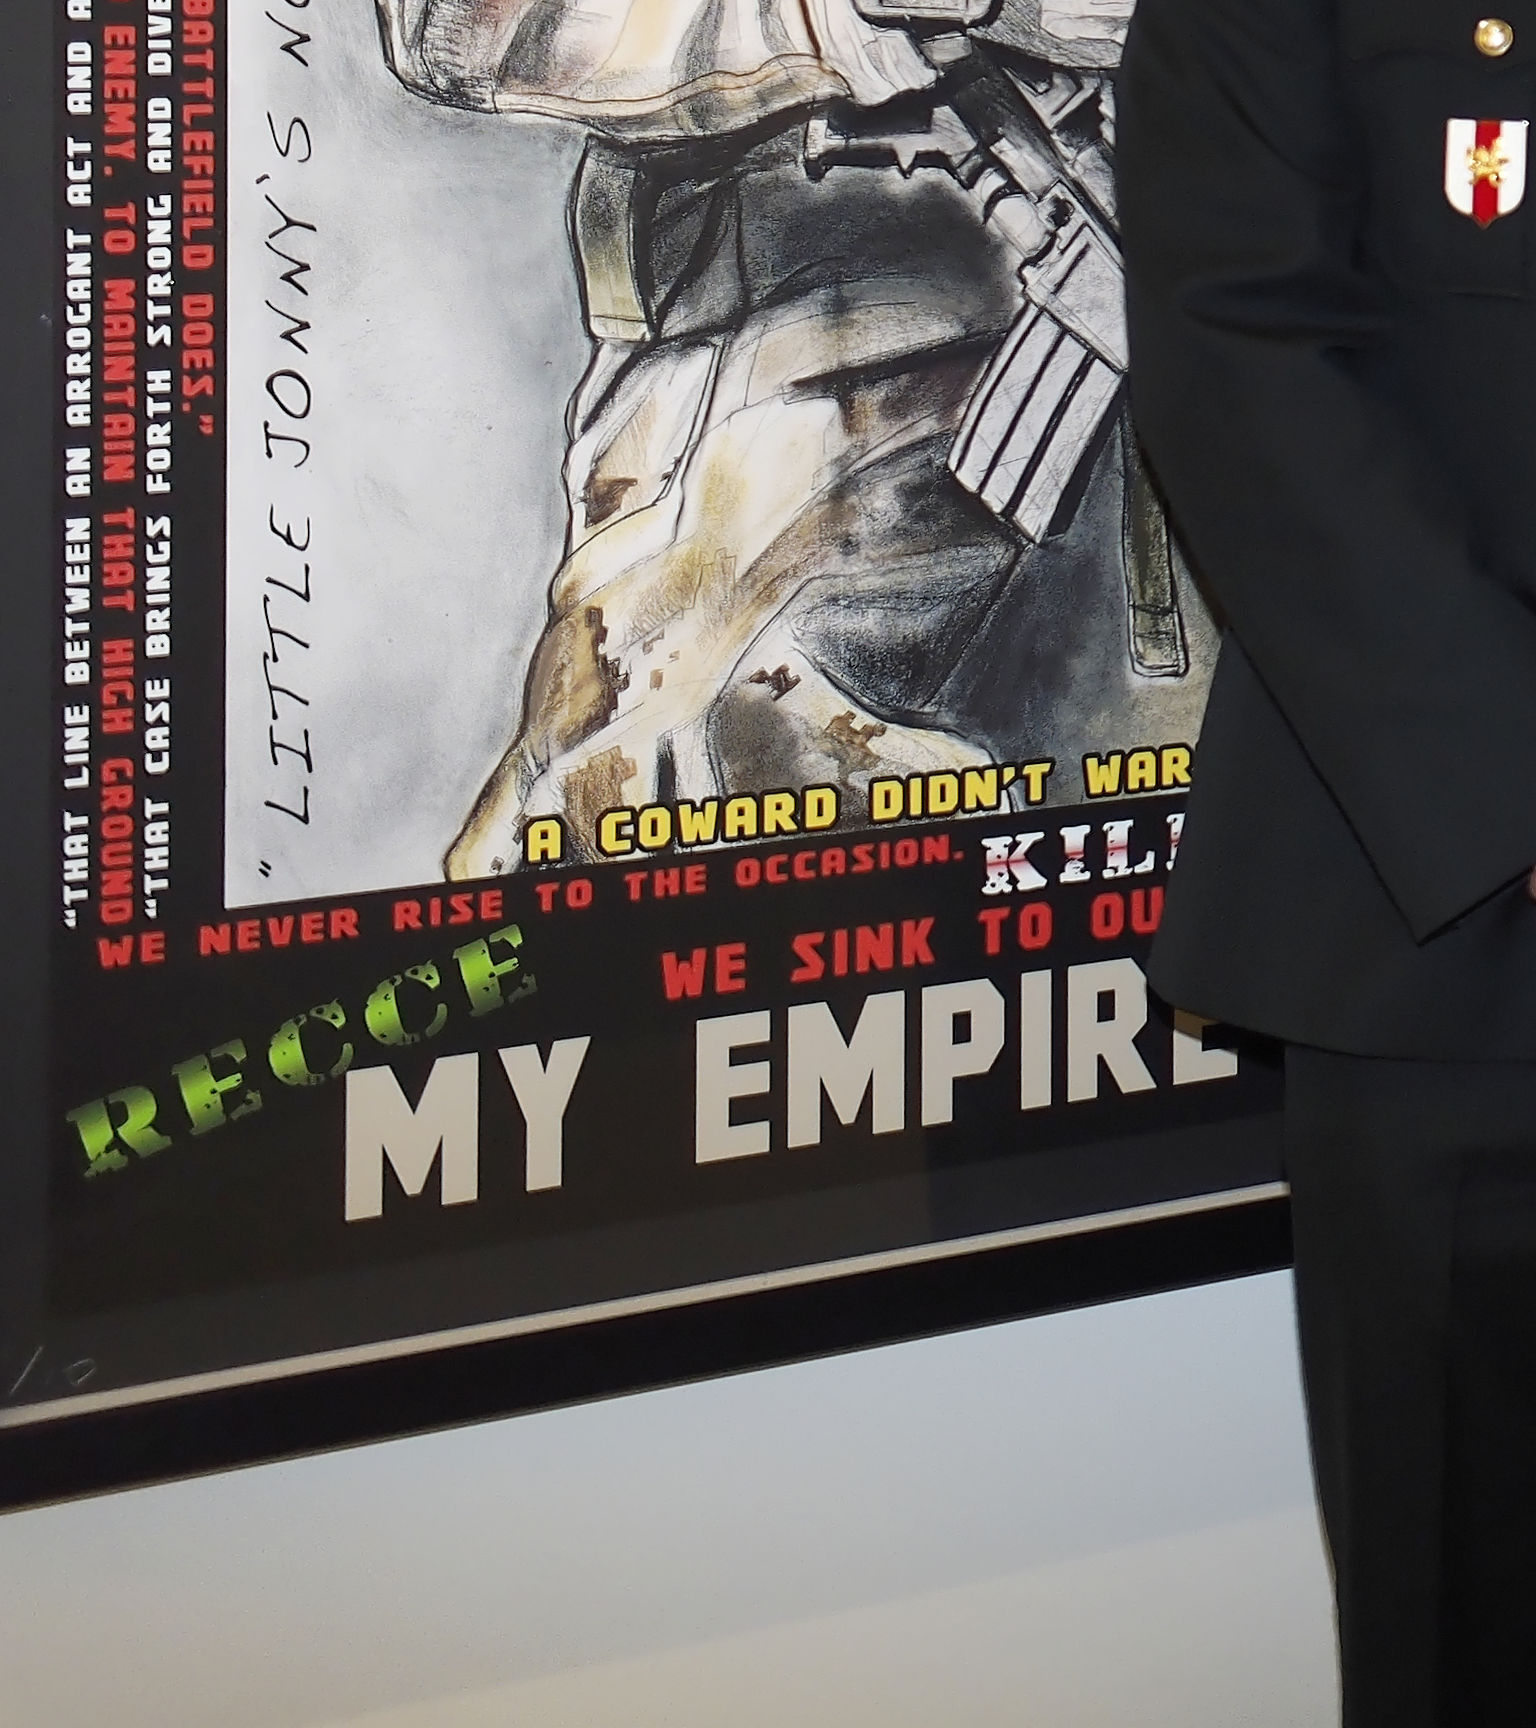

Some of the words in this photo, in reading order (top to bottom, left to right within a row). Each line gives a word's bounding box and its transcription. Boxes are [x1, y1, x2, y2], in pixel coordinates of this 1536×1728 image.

[66, 40, 92, 114] AND
[101, 23, 137, 176] ENEMY.
[66, 135, 92, 205] ACT
[101, 203, 137, 256] TO
[66, 227, 92, 425] ARROGANT
[101, 277, 136, 483] MAINTAIN
[65, 446, 91, 495] AN
[64, 516, 91, 683] BETWEEN
[100, 507, 136, 612] THAT
[99, 638, 134, 735] HIGH
[63, 704, 90, 787] LINE
[98, 757, 134, 926] GROUND
[528, 819, 562, 862] A
[600, 787, 837, 854] COWARD
[97, 930, 165, 969] WE
[197, 907, 360, 956] NEVER
[391, 889, 502, 932] RISE
[535, 878, 594, 913] TO
[624, 863, 707, 902] THE
[733, 835, 963, 889] OCCASION.
[660, 942, 747, 1001] WE
[790, 917, 934, 983] SINK
[979, 902, 1053, 956] TO
[66, 924, 537, 1178] RECCE
[343, 1035, 591, 1222] MY
